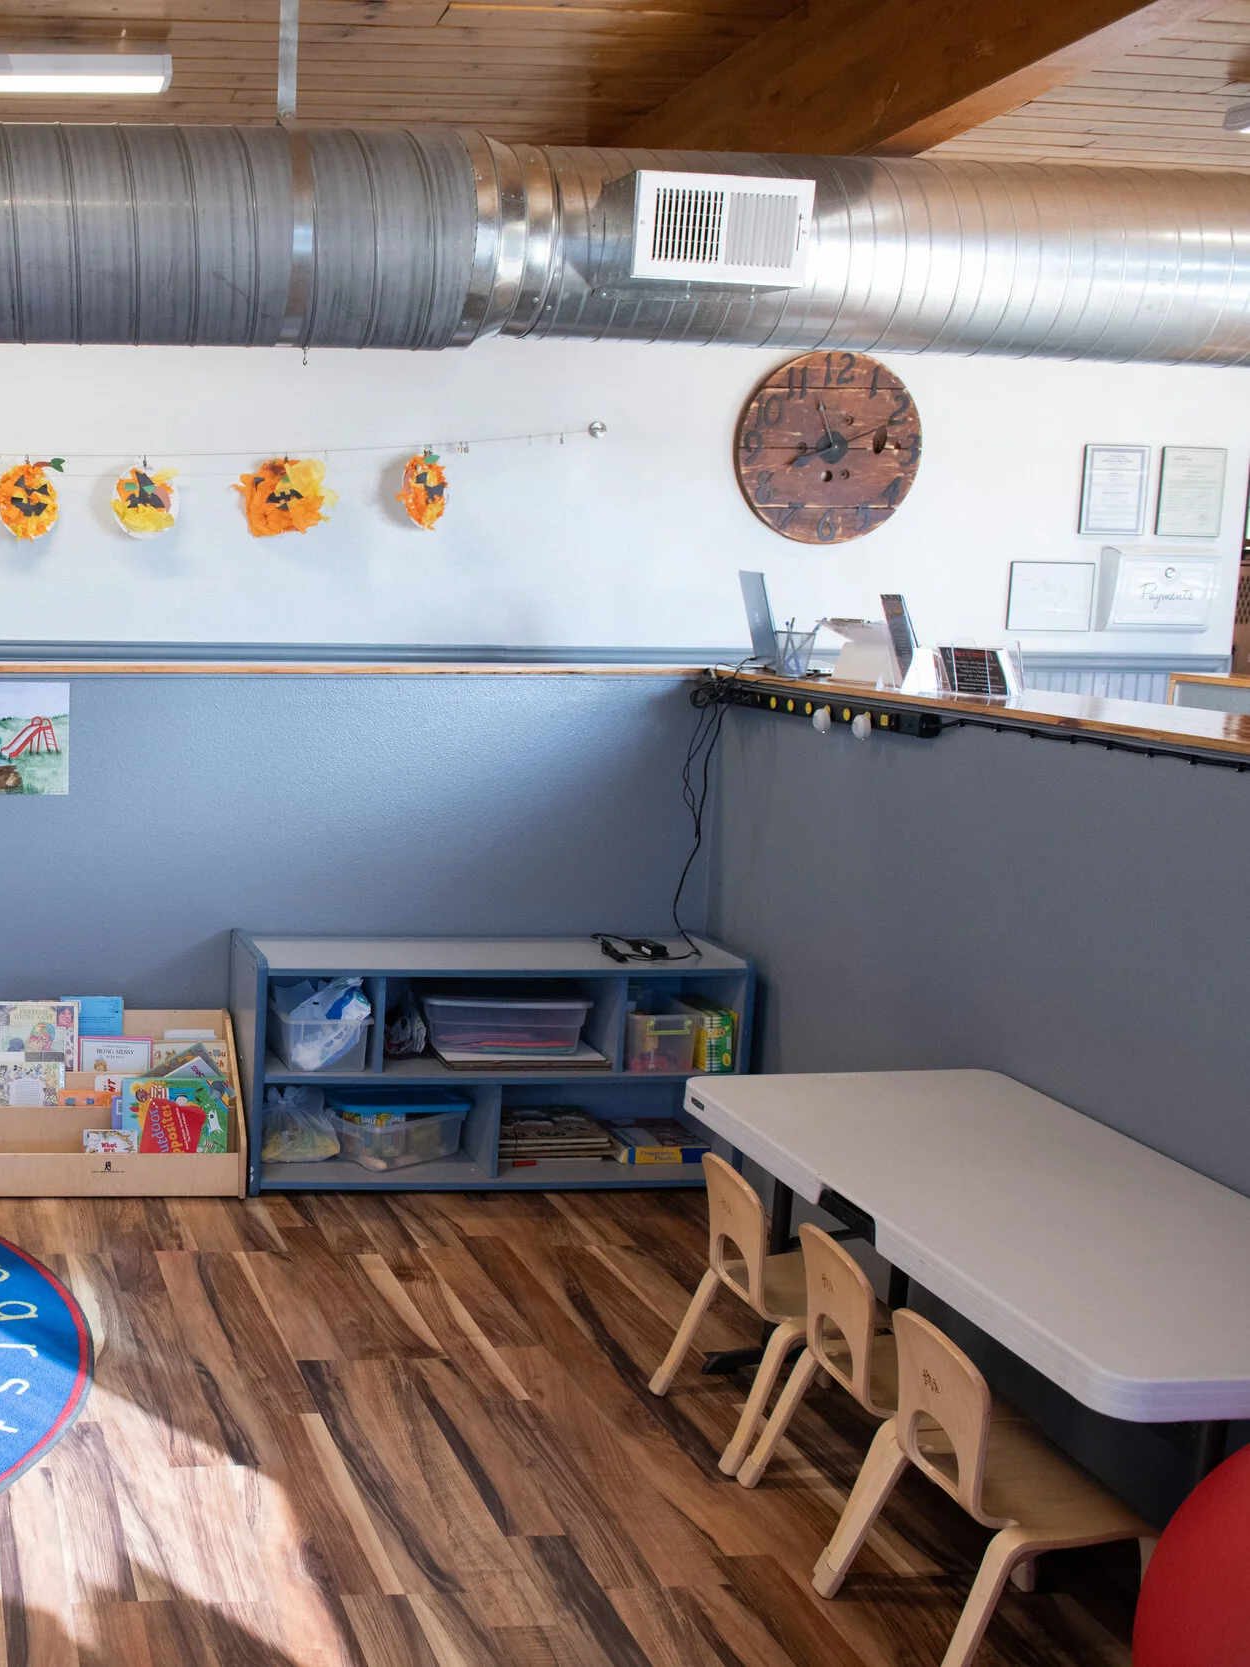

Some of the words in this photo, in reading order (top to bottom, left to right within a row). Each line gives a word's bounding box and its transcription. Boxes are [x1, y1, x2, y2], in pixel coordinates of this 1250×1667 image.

[787, 366, 808, 400] 11
[824, 352, 856, 387] 12
[869, 365, 880, 399] 1
[756, 394, 784, 429] 10
[887, 390, 910, 426] 2
[744, 430, 763, 466] 9
[898, 433, 921, 467] 3
[755, 470, 775, 504] 8
[880, 476, 901, 508] 4
[777, 501, 805, 530] 7
[817, 507, 836, 541] 6
[854, 503, 871, 532] 5
[1139, 582, 1194, 610] Payments
[149, 1108, 169, 1153] utdoor
[162, 1104, 185, 1153] pposites
